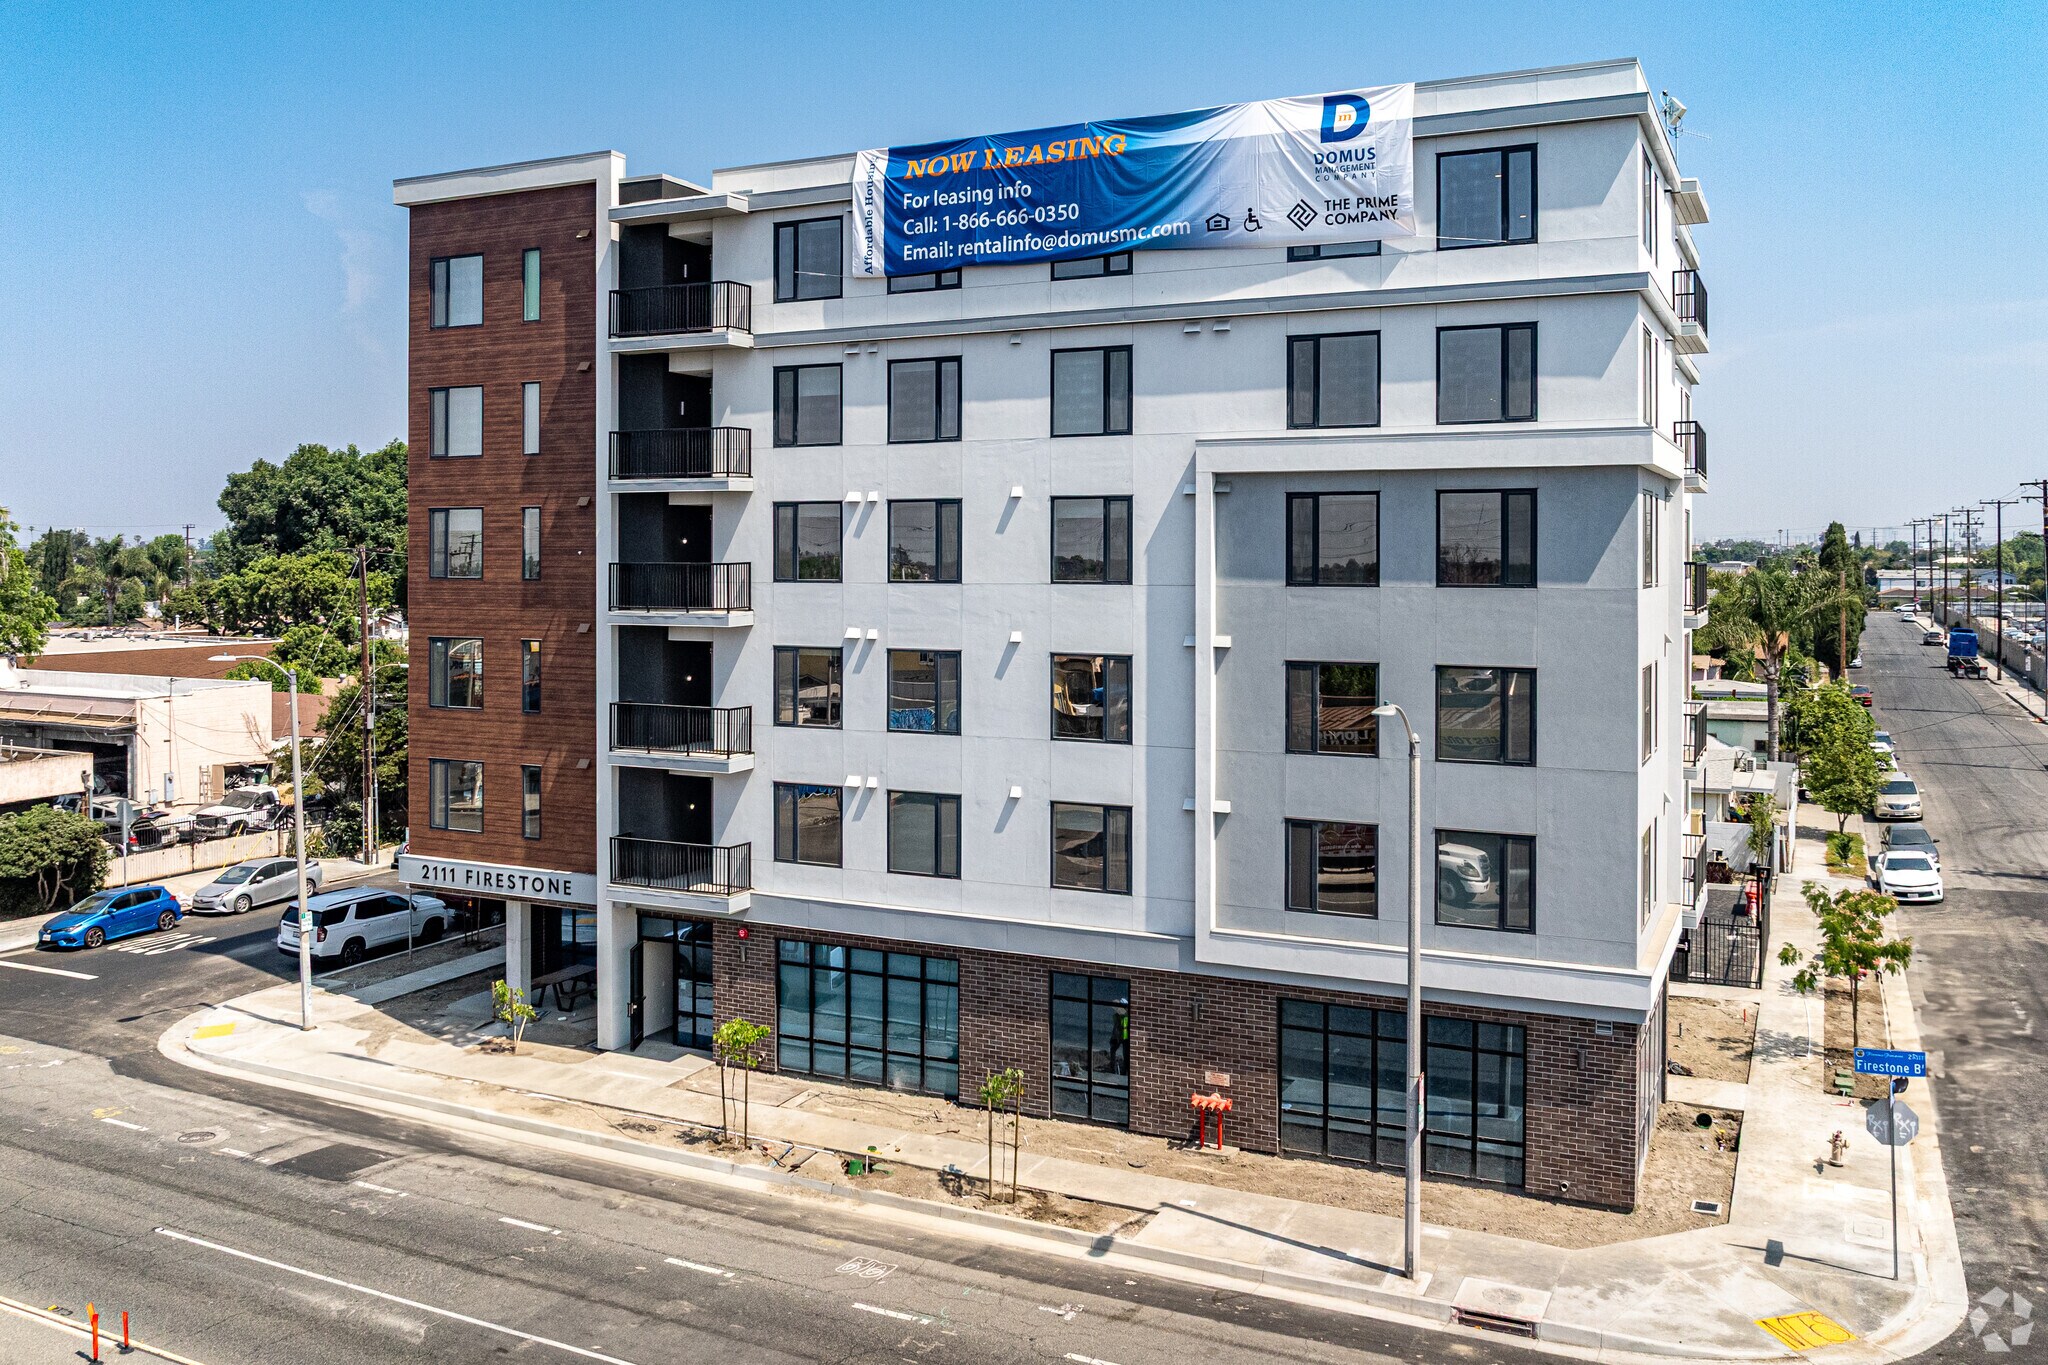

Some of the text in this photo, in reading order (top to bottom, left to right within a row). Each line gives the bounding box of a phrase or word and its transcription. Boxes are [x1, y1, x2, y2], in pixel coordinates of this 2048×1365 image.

[904, 134, 1127, 179] NOW LEASING
[1313, 147, 1376, 164] DOMUS
[1315, 162, 1376, 174] MANAGEMENT
[1315, 171, 1376, 182] COMPANY
[903, 180, 1032, 209] For leasing info
[1324, 194, 1398, 212] THE PRIME
[864, 156, 879, 275] Affordable Housing
[903, 203, 1080, 235] Call: 1-866-666-0350
[1325, 209, 1398, 226] COMPANY
[903, 220, 1191, 261] Email: rentalinfo@domusmc.com
[421, 865, 572, 896] 2111 FIRESTONE
[1856, 1059, 1910, 1074] Firestone
